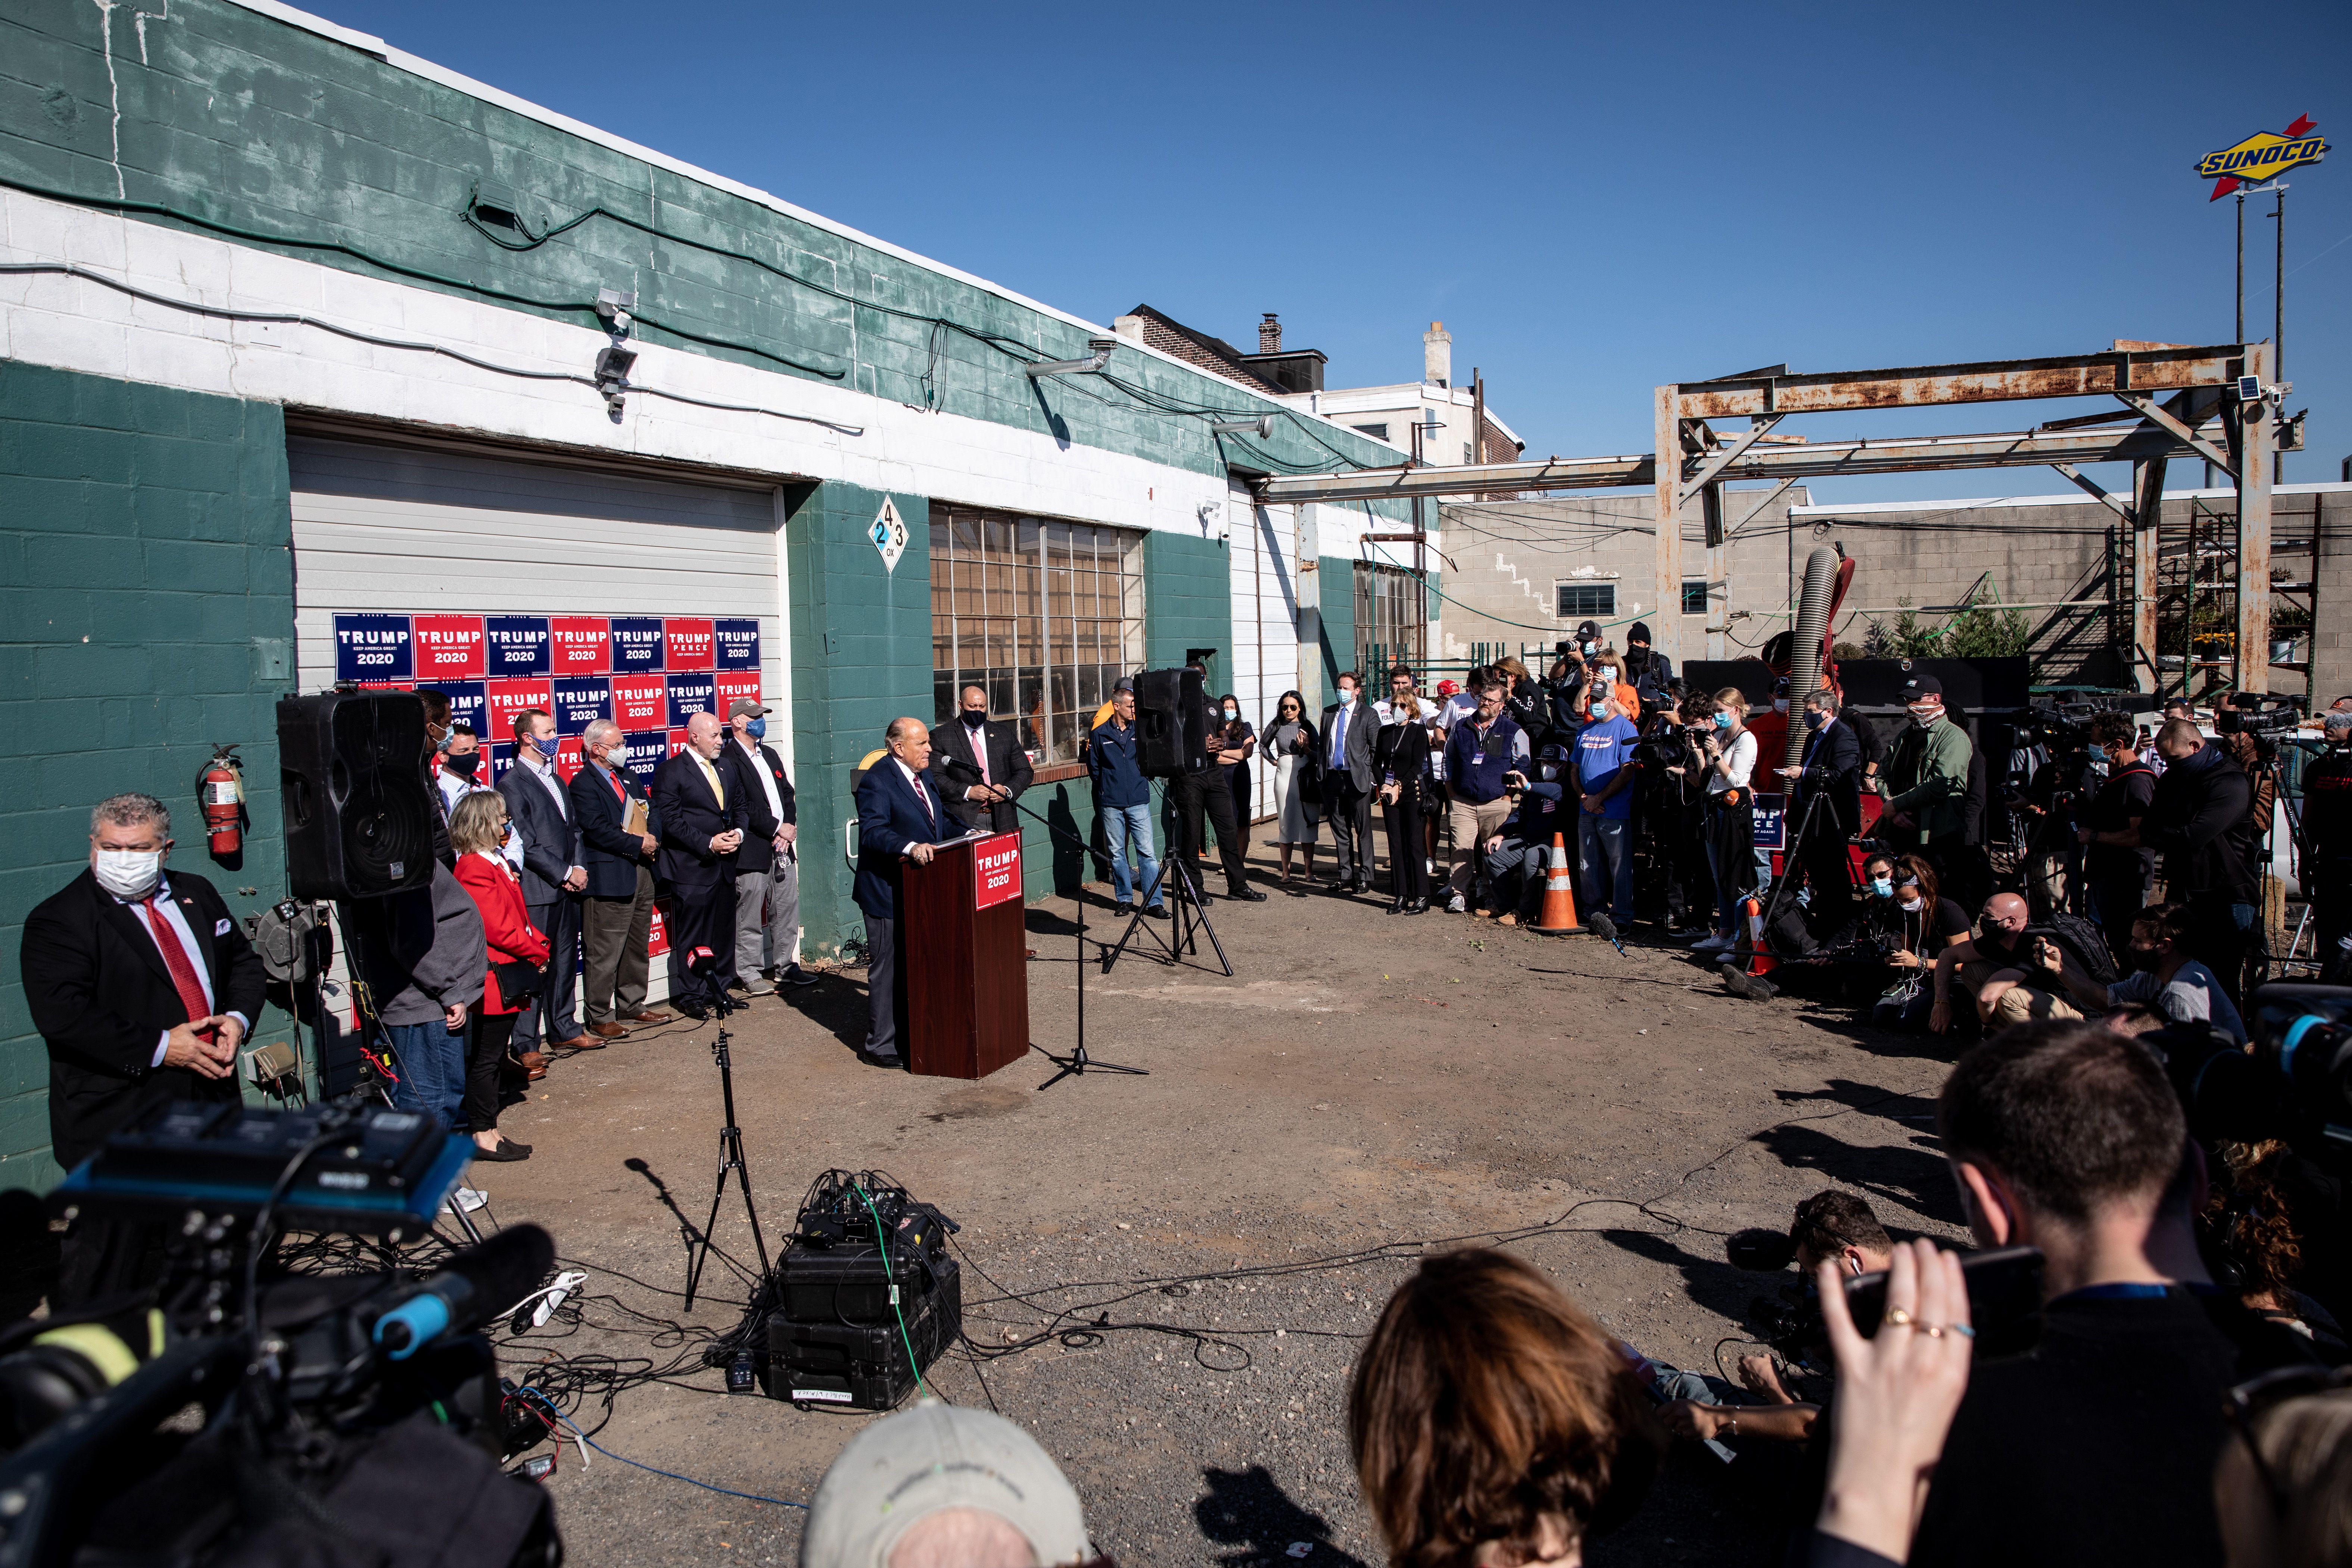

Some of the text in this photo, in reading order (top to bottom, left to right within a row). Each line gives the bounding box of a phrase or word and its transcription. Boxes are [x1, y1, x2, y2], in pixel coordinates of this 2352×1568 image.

[2204, 140, 2322, 172] SUNOCO
[885, 505, 892, 526] 4
[876, 522, 903, 546] 2 3
[887, 548, 894, 557] OX
[339, 631, 408, 643] TRUMP
[418, 631, 481, 643] TRUMP
[490, 632, 547, 643] TRUMP
[555, 632, 607, 642] TRUMP
[614, 632, 661, 642] TRUMP
[669, 634, 710, 643] TRUMP
[717, 632, 757, 641] TRUMP
[435, 653, 468, 663] 2020
[505, 652, 535, 661] 2020
[568, 651, 596, 660] 2020
[626, 650, 651, 659] 2020
[728, 649, 749, 657] 2020
[358, 654, 394, 664] 2020
[616, 688, 663, 700] TRUMP
[669, 686, 713, 698] TRUMP
[719, 684, 758, 695] TRUMP
[450, 696, 483, 709] UMP
[492, 693, 548, 707] TRUMP
[557, 691, 608, 703] TRUMP
[629, 707, 653, 717] 2020
[681, 704, 704, 713] 2020
[571, 710, 598, 721] 2020
[627, 745, 664, 757] RUMP
[978, 850, 1017, 871] TRUMP
[988, 873, 1009, 889] 2020
[649, 932, 660, 942] 20
